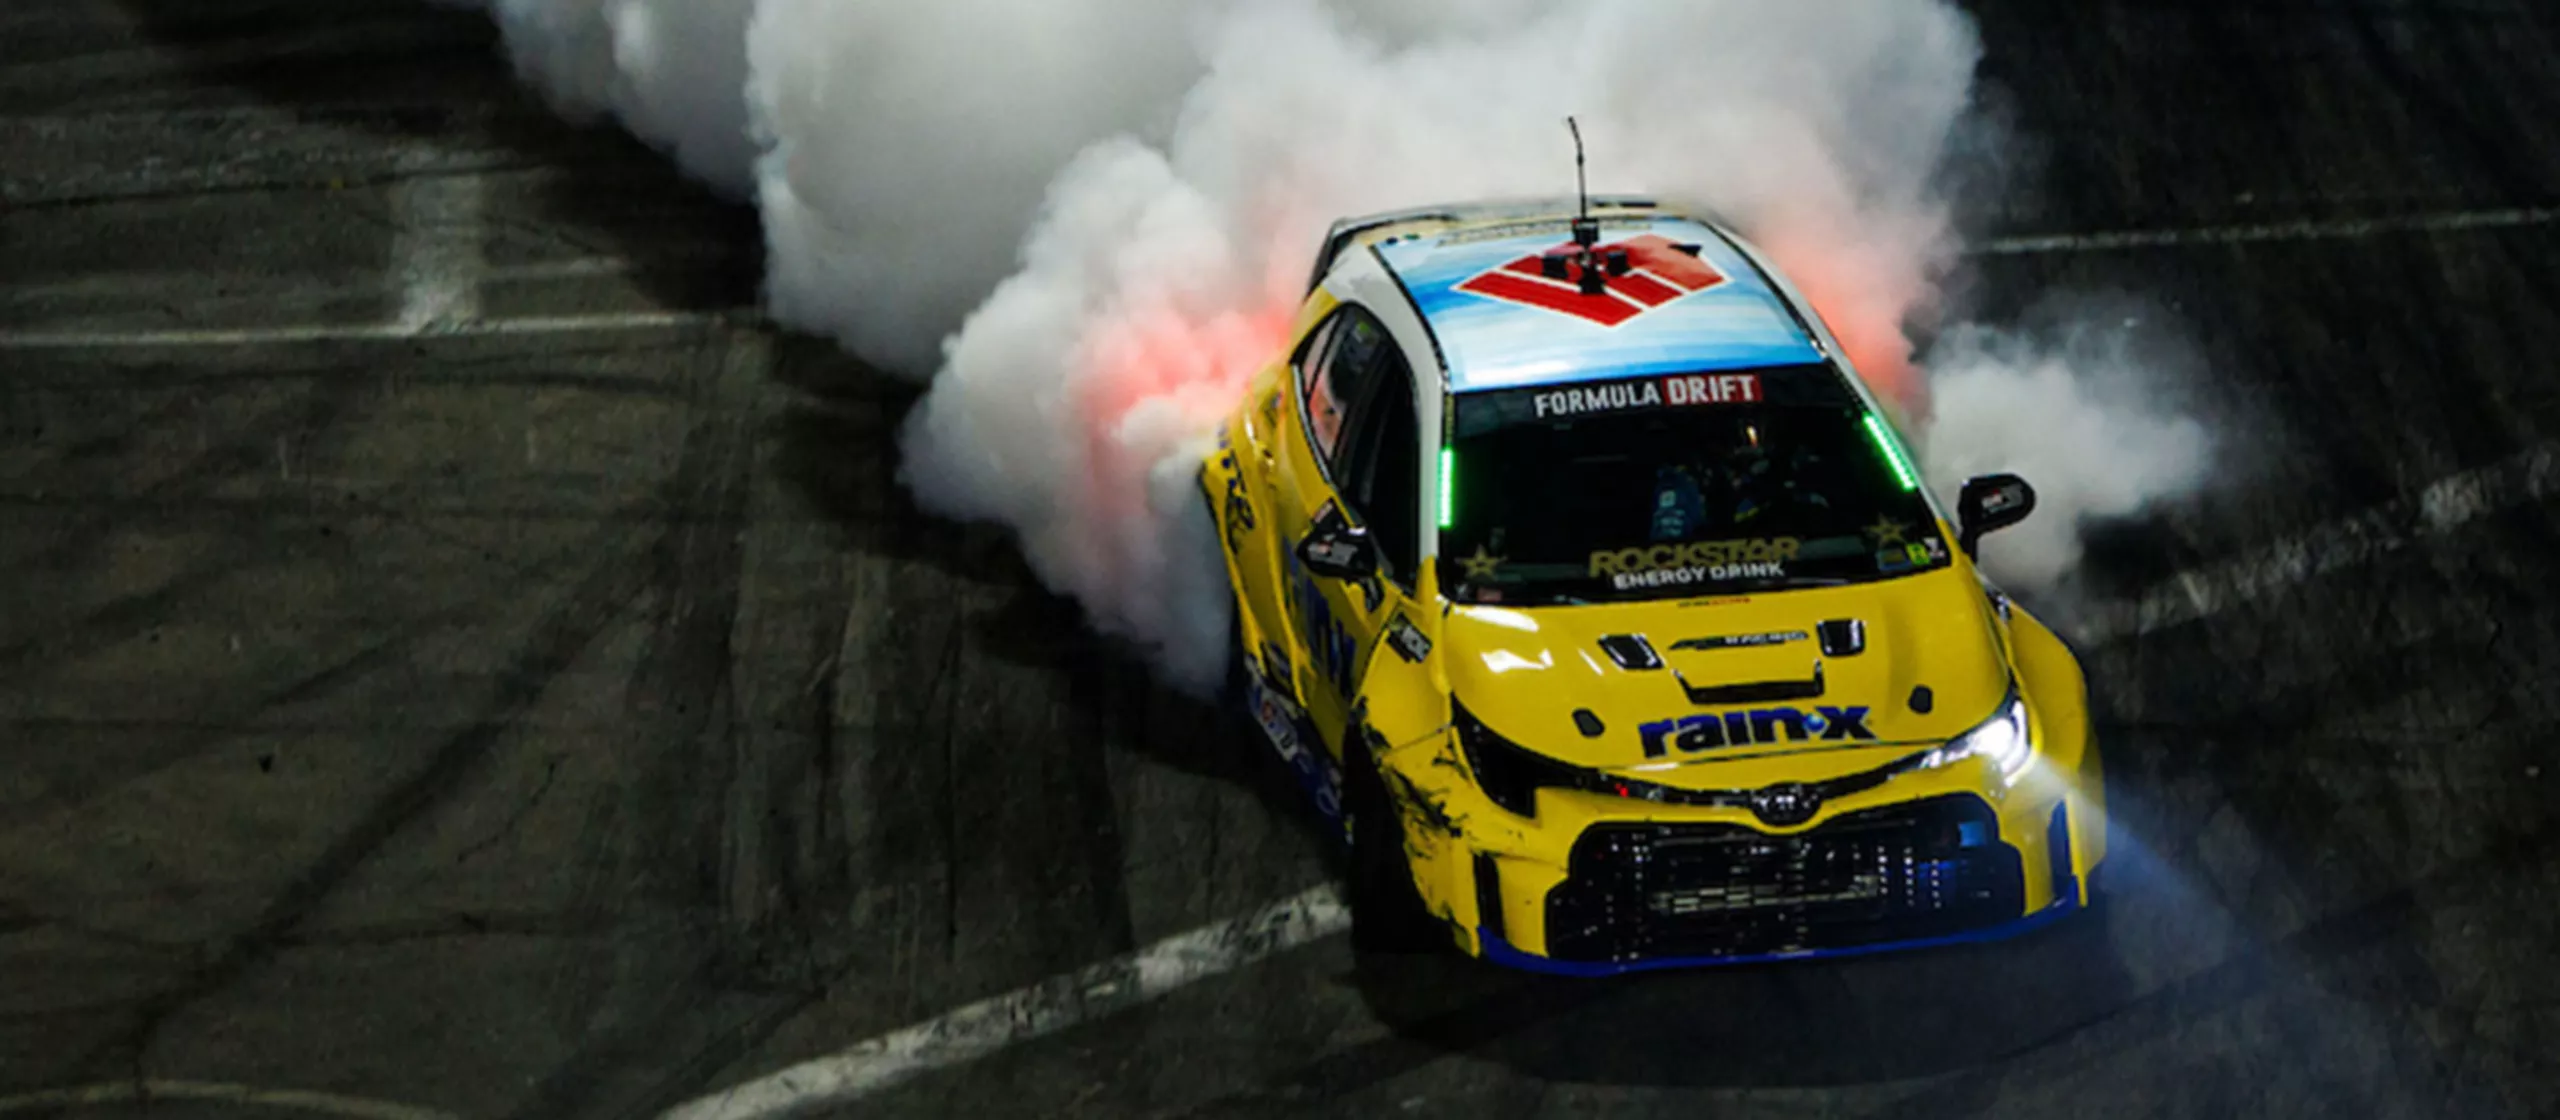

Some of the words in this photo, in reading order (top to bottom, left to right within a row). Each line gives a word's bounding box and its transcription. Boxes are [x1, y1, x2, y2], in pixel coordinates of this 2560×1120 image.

[1534, 381, 1662, 418] FORMULA
[1667, 374, 1756, 405] DRIFT
[1588, 536, 1800, 578] ROCKSTAR
[1613, 566, 1706, 590] ENERGY
[1709, 560, 1785, 582] DRINK
